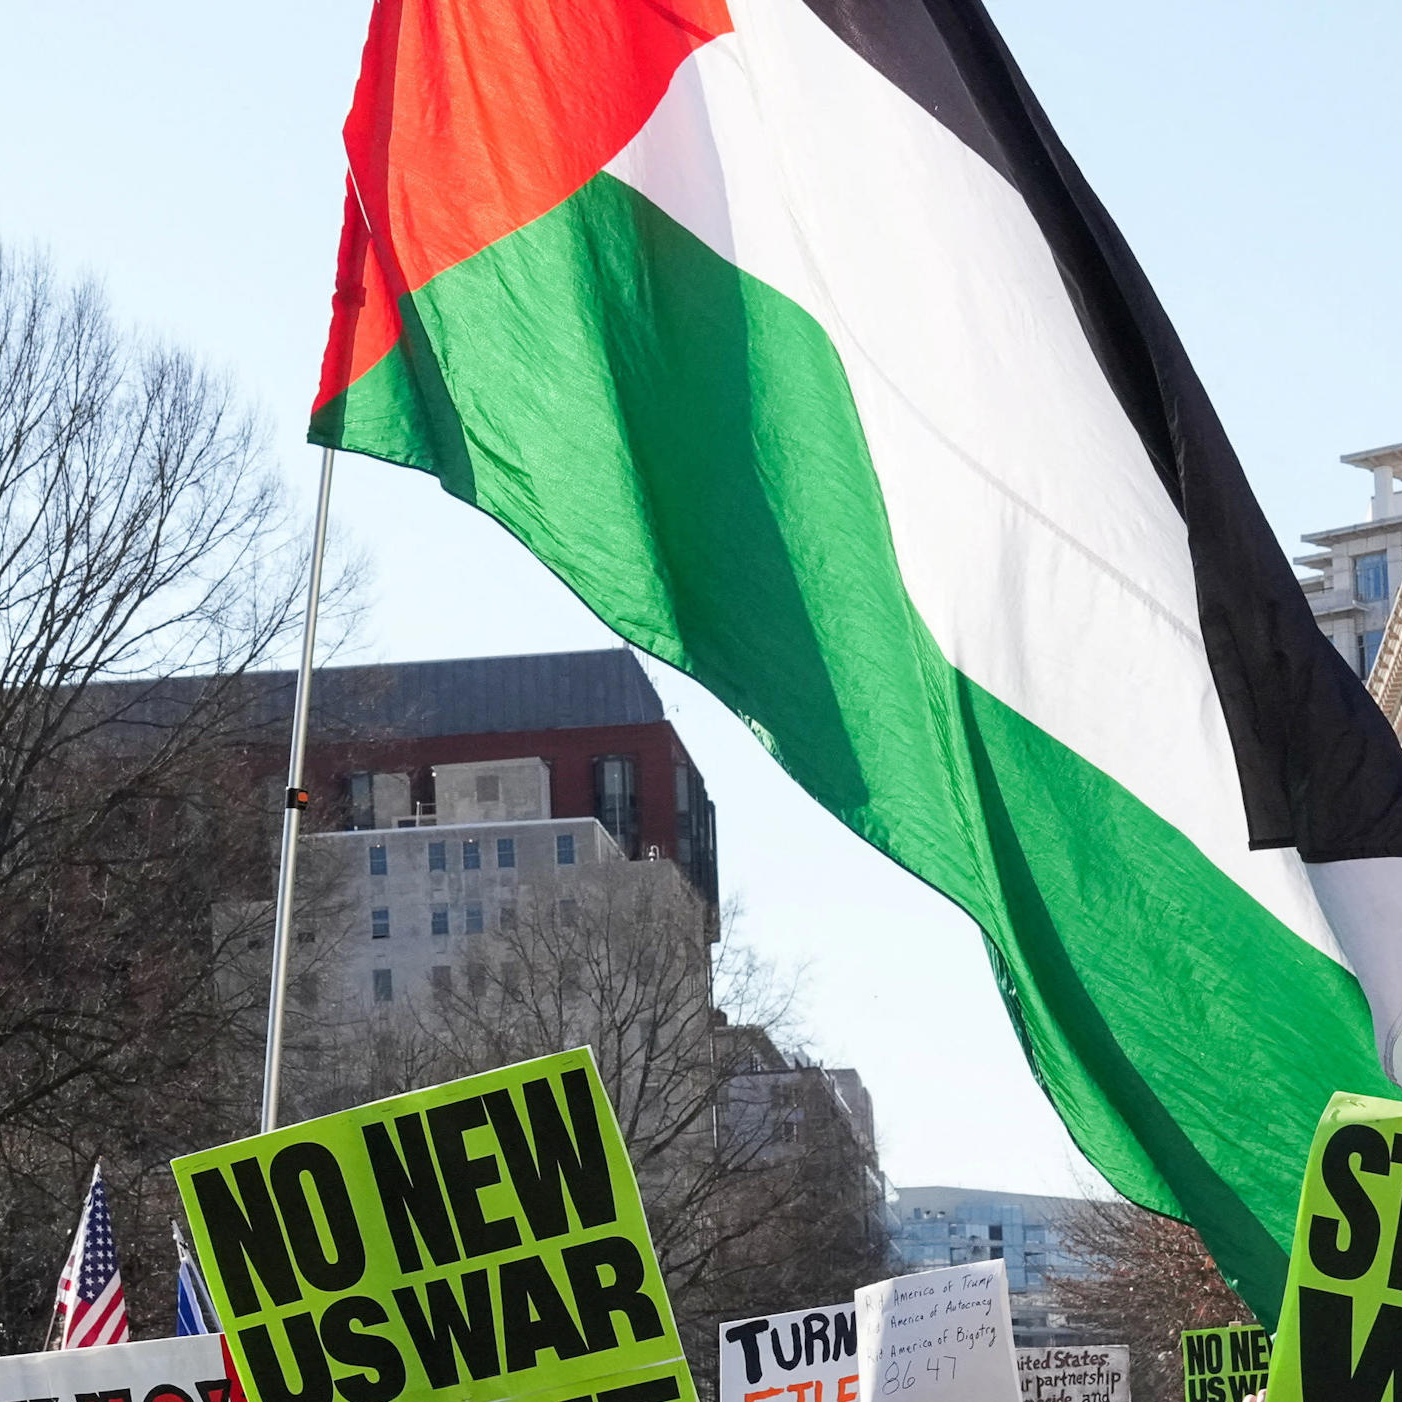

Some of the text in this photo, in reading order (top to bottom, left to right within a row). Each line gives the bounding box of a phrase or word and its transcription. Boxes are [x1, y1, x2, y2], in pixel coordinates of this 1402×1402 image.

[191, 1068, 617, 1319] NO NEW
[894, 1288, 934, 1306] America
[943, 1283, 954, 1294] of
[962, 1273, 995, 1291] Trump
[391, 1235, 665, 1390] WAR
[891, 1314, 924, 1329] America
[930, 1304, 939, 1318] of
[945, 1298, 992, 1316] Autocracy
[890, 1342, 933, 1358] America
[938, 1329, 950, 1345] of
[1186, 1333, 1223, 1376] NO
[882, 1355, 958, 1396] 86 47
[1036, 1367, 1121, 1398] partnership
